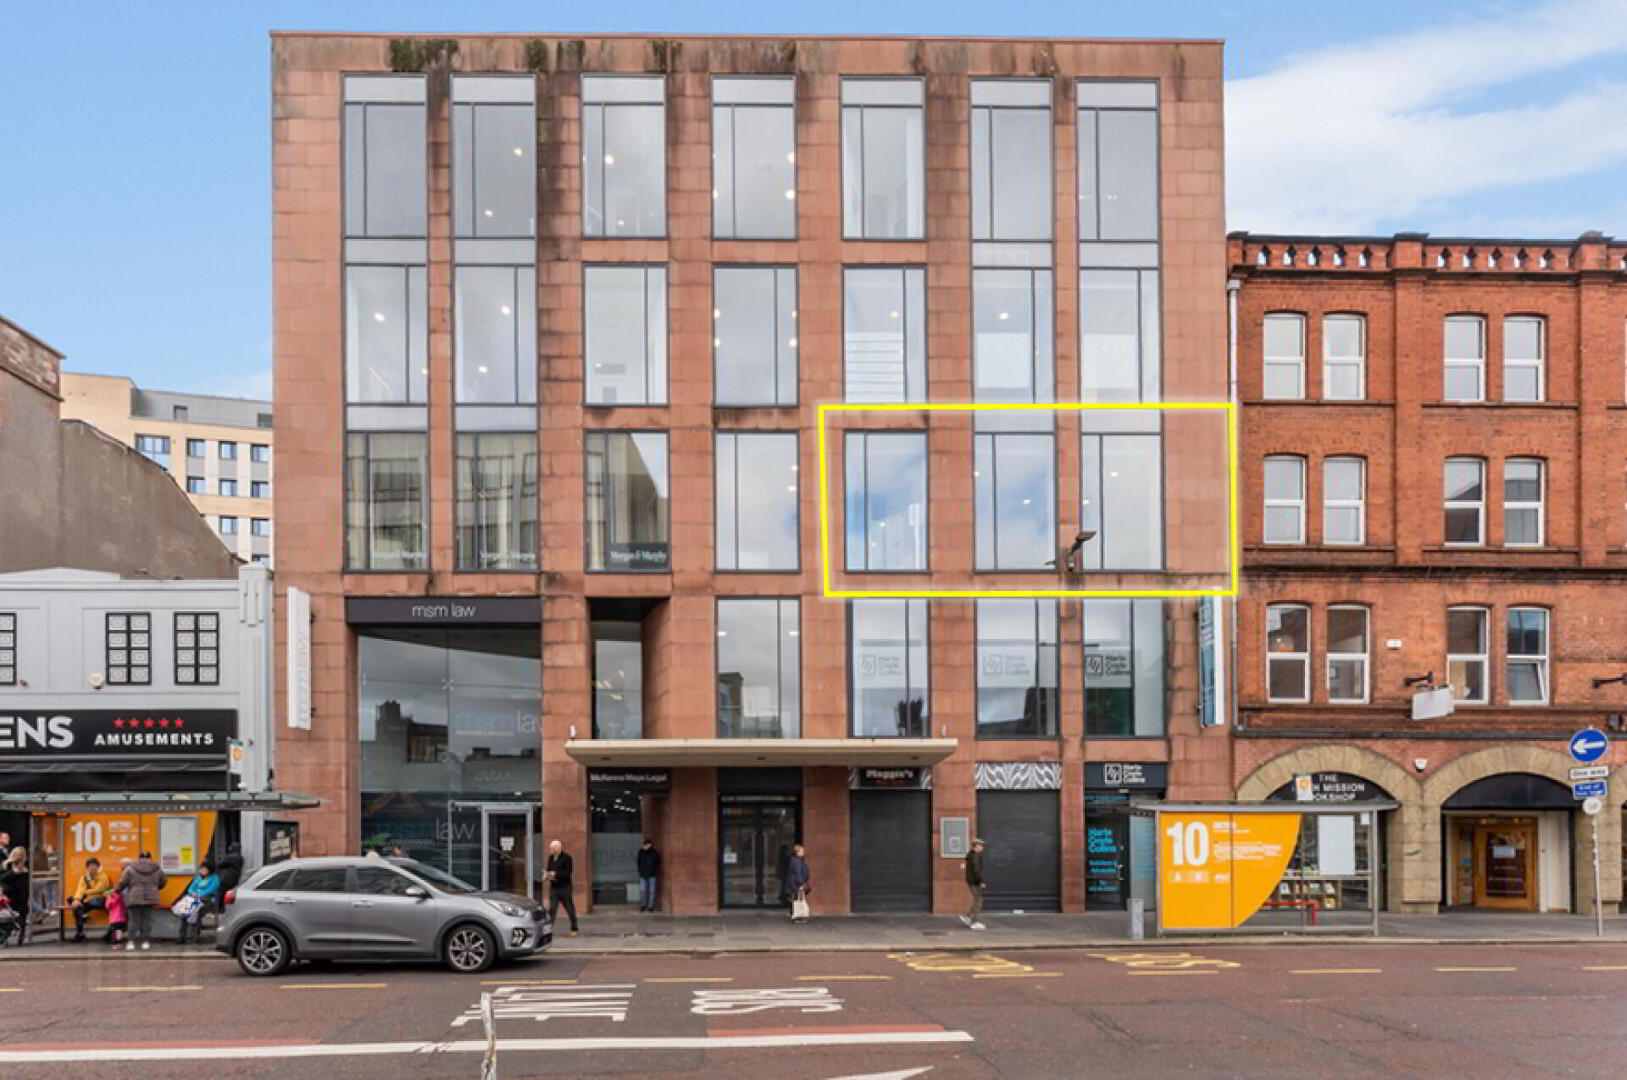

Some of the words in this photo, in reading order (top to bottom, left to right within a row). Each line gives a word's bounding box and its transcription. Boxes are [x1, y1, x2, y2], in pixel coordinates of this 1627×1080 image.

[412, 605, 449, 617] msm
[451, 603, 477, 617] law
[94, 732, 214, 746] AMUSEMENTS
[1319, 774, 1338, 782] THE
[1323, 782, 1365, 792] MISSION
[71, 821, 103, 853] 10
[1165, 821, 1210, 866] 10
